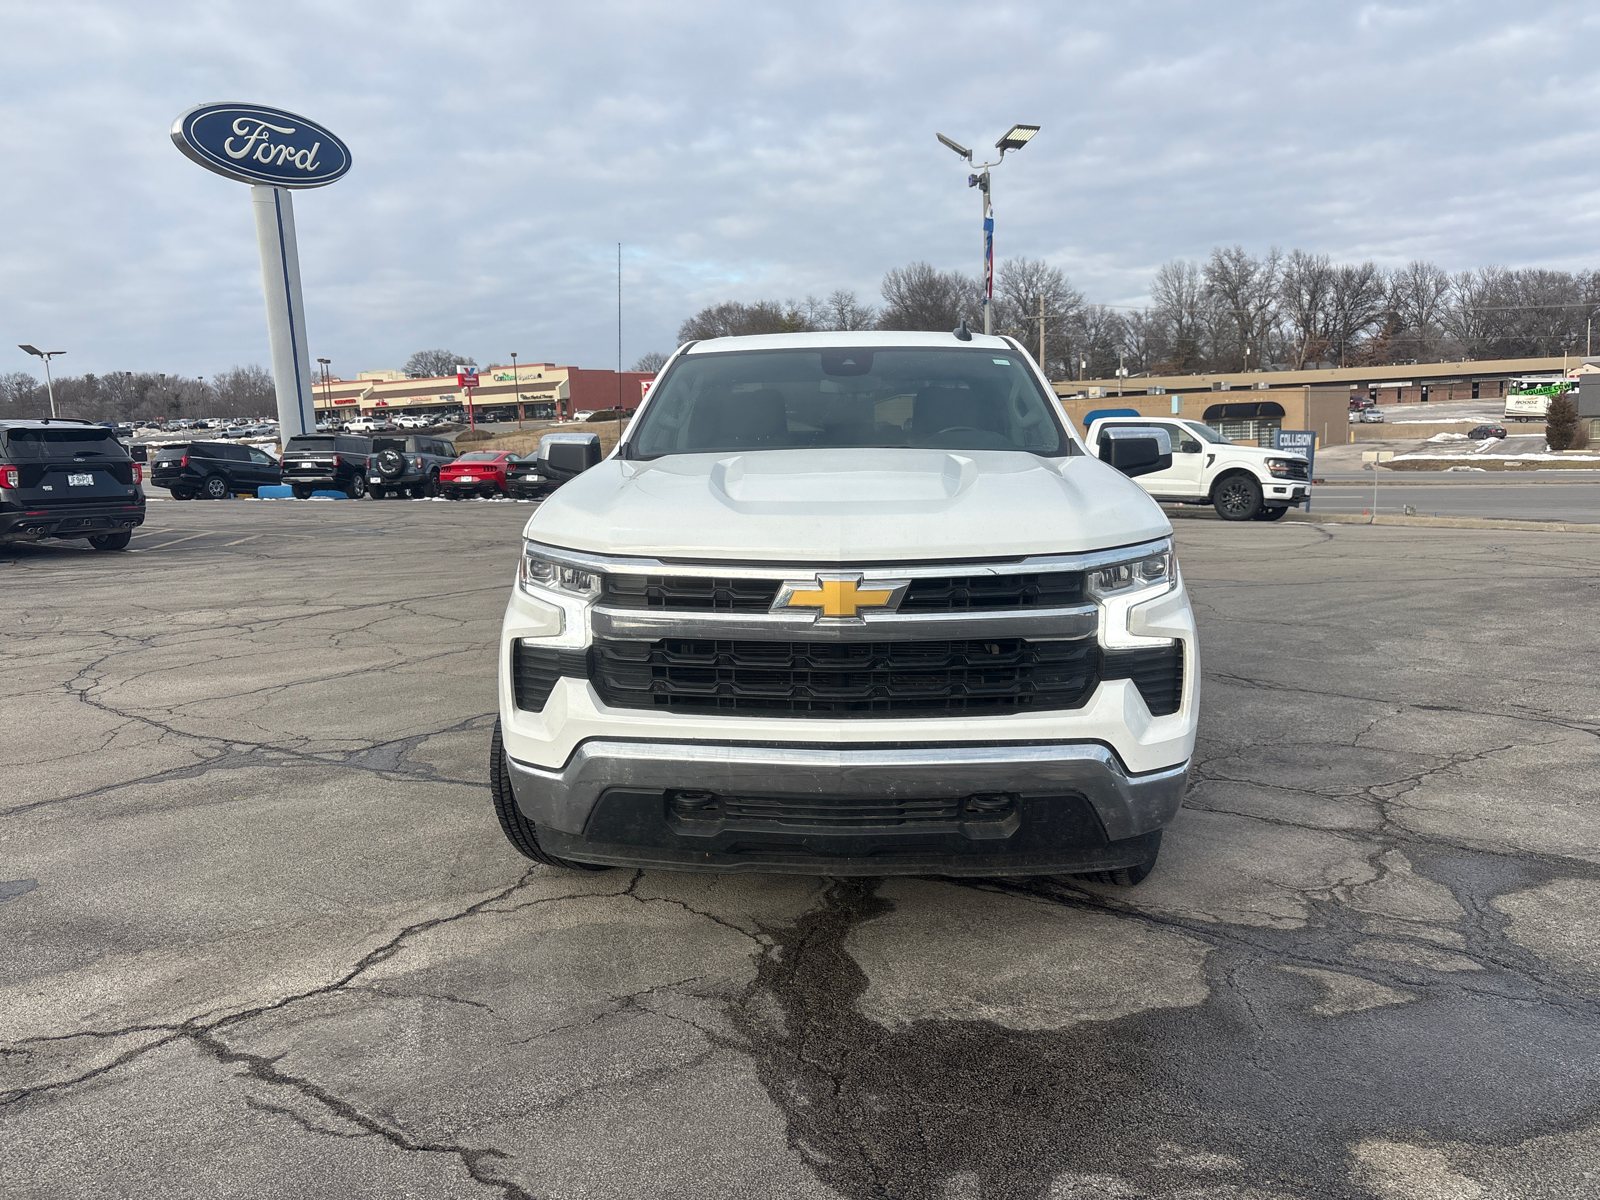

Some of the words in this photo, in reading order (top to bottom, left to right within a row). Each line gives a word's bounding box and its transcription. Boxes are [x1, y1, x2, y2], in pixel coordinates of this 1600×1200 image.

[224, 117, 321, 172] Ford
[1524, 386, 1552, 395] SQUARE
[1280, 434, 1311, 446] COLLISION
